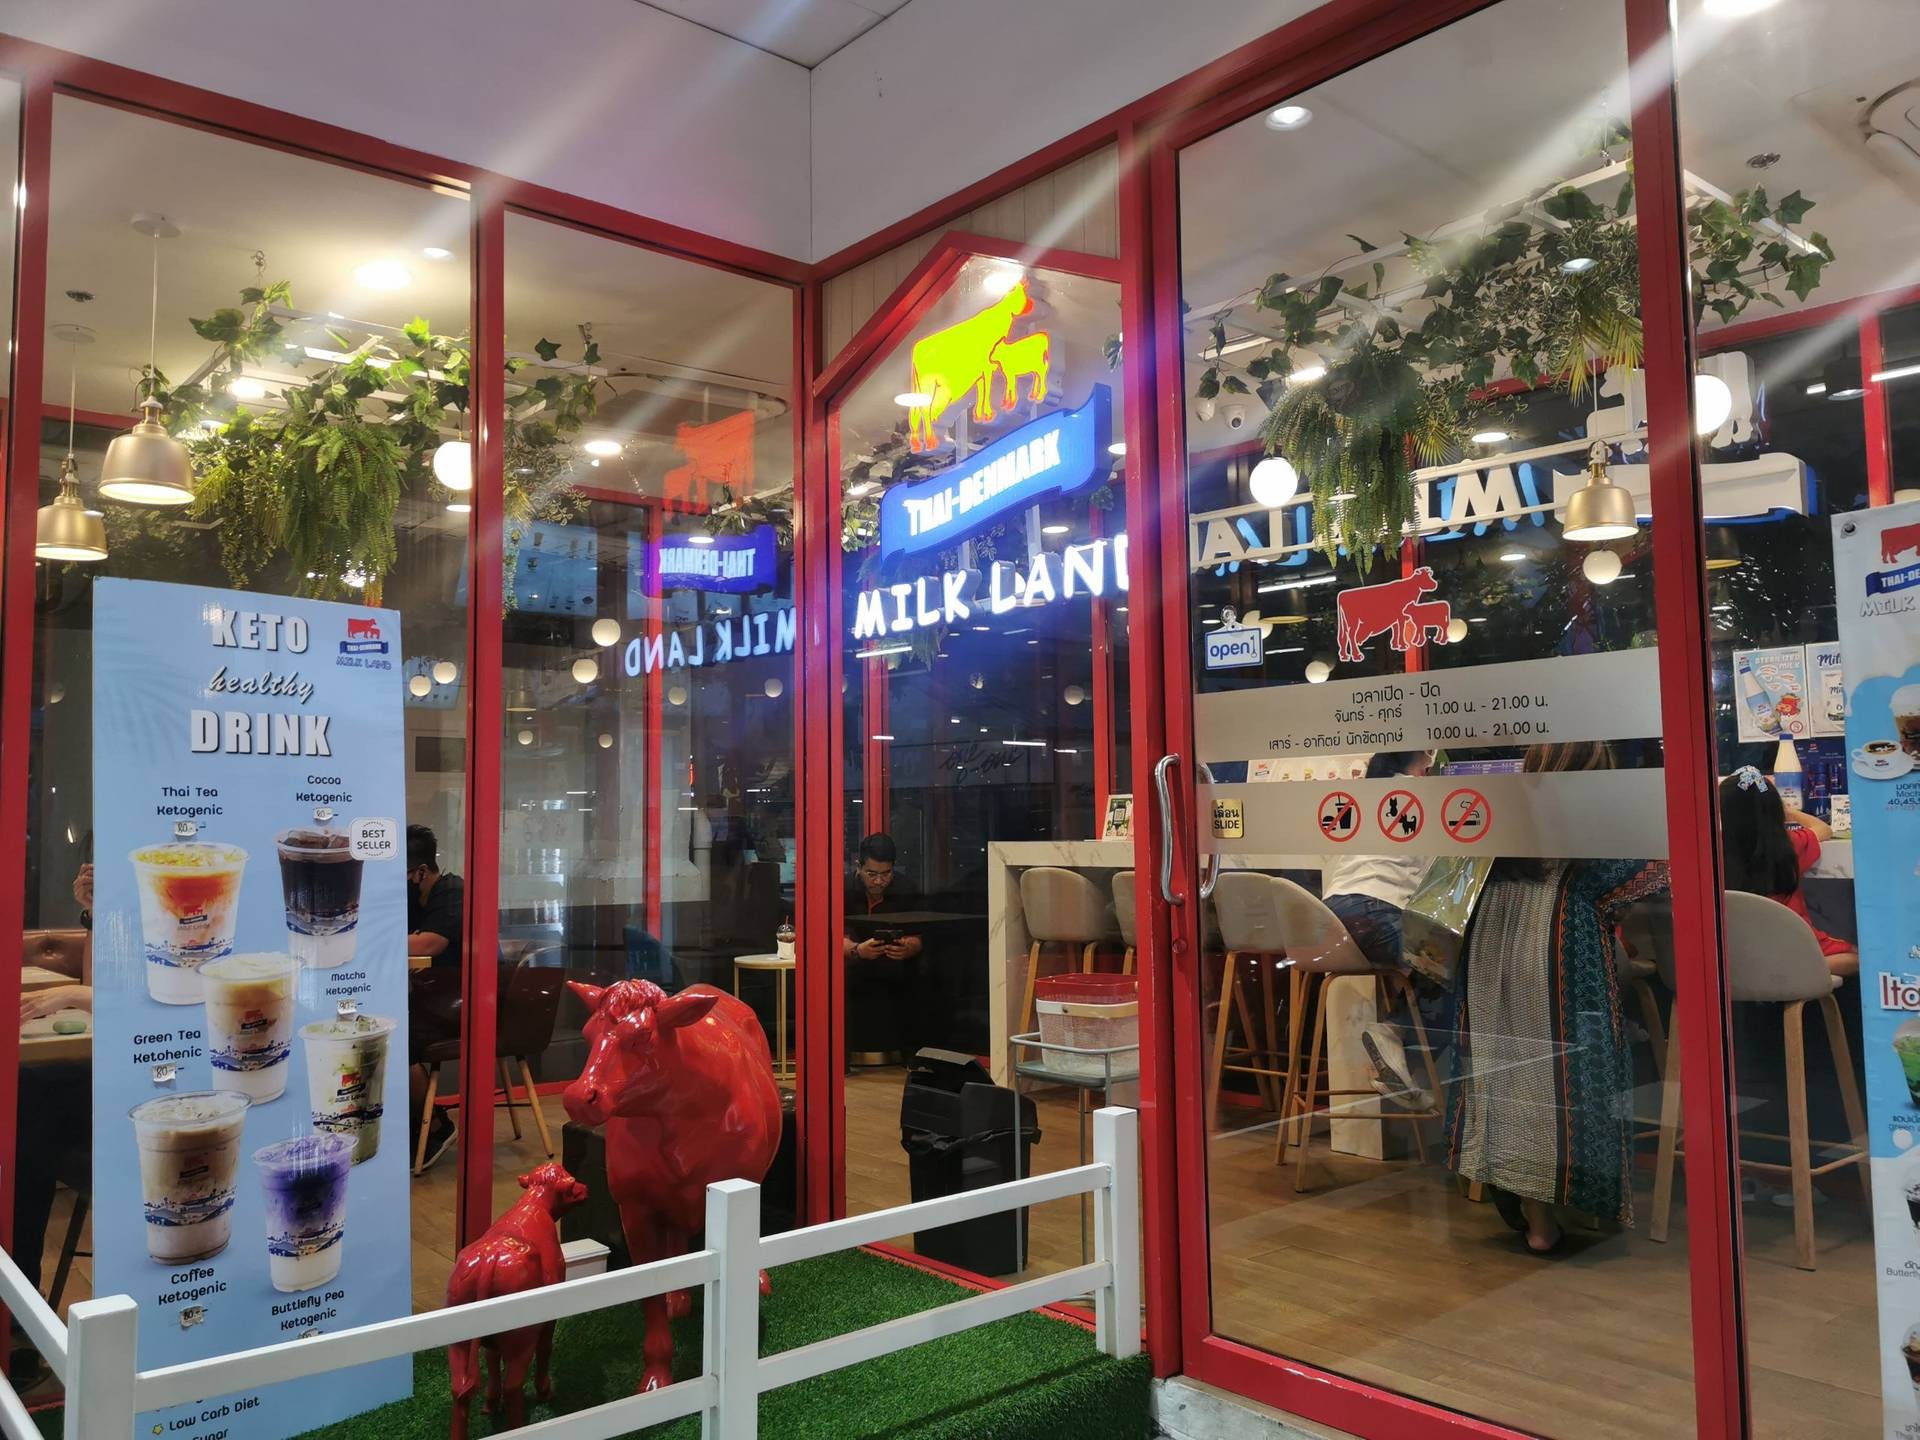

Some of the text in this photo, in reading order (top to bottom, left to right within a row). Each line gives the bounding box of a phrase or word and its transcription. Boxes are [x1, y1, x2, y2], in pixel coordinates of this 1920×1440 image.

[902, 429, 1062, 537] THAI-DENMARK
[853, 568, 971, 639] MILK
[211, 609, 309, 654] KETO
[1210, 641, 1250, 660] open
[208, 666, 314, 704] healthy
[1420, 681, 1441, 698] ปิด
[1425, 701, 1459, 716] 11.00
[1491, 695, 1530, 711] 21.00
[190, 709, 332, 757] DRINK
[1426, 726, 1461, 740] 10.00
[1493, 721, 1531, 737] 21.00
[307, 775, 341, 785] Cocoa
[161, 785, 219, 797] Thai Tea
[296, 791, 353, 804] Ketogenic
[156, 804, 224, 818] Ketogenic
[1214, 819, 1240, 829] SLIDE
[361, 829, 386, 839] BEST
[356, 840, 391, 850] SELLER
[331, 971, 366, 981] Matcha
[325, 983, 372, 996] Ketogenic
[133, 1029, 202, 1045] Green Tea
[132, 1046, 203, 1064] Ketohenic
[170, 1267, 215, 1285] Coffee
[158, 1280, 227, 1306] Ketogenic
[324, 1290, 345, 1302] Pea
[280, 1307, 337, 1331] Ketogenic
[169, 1416, 196, 1431] Low
[201, 1405, 230, 1422] Carb
[234, 1396, 260, 1413] Diet
